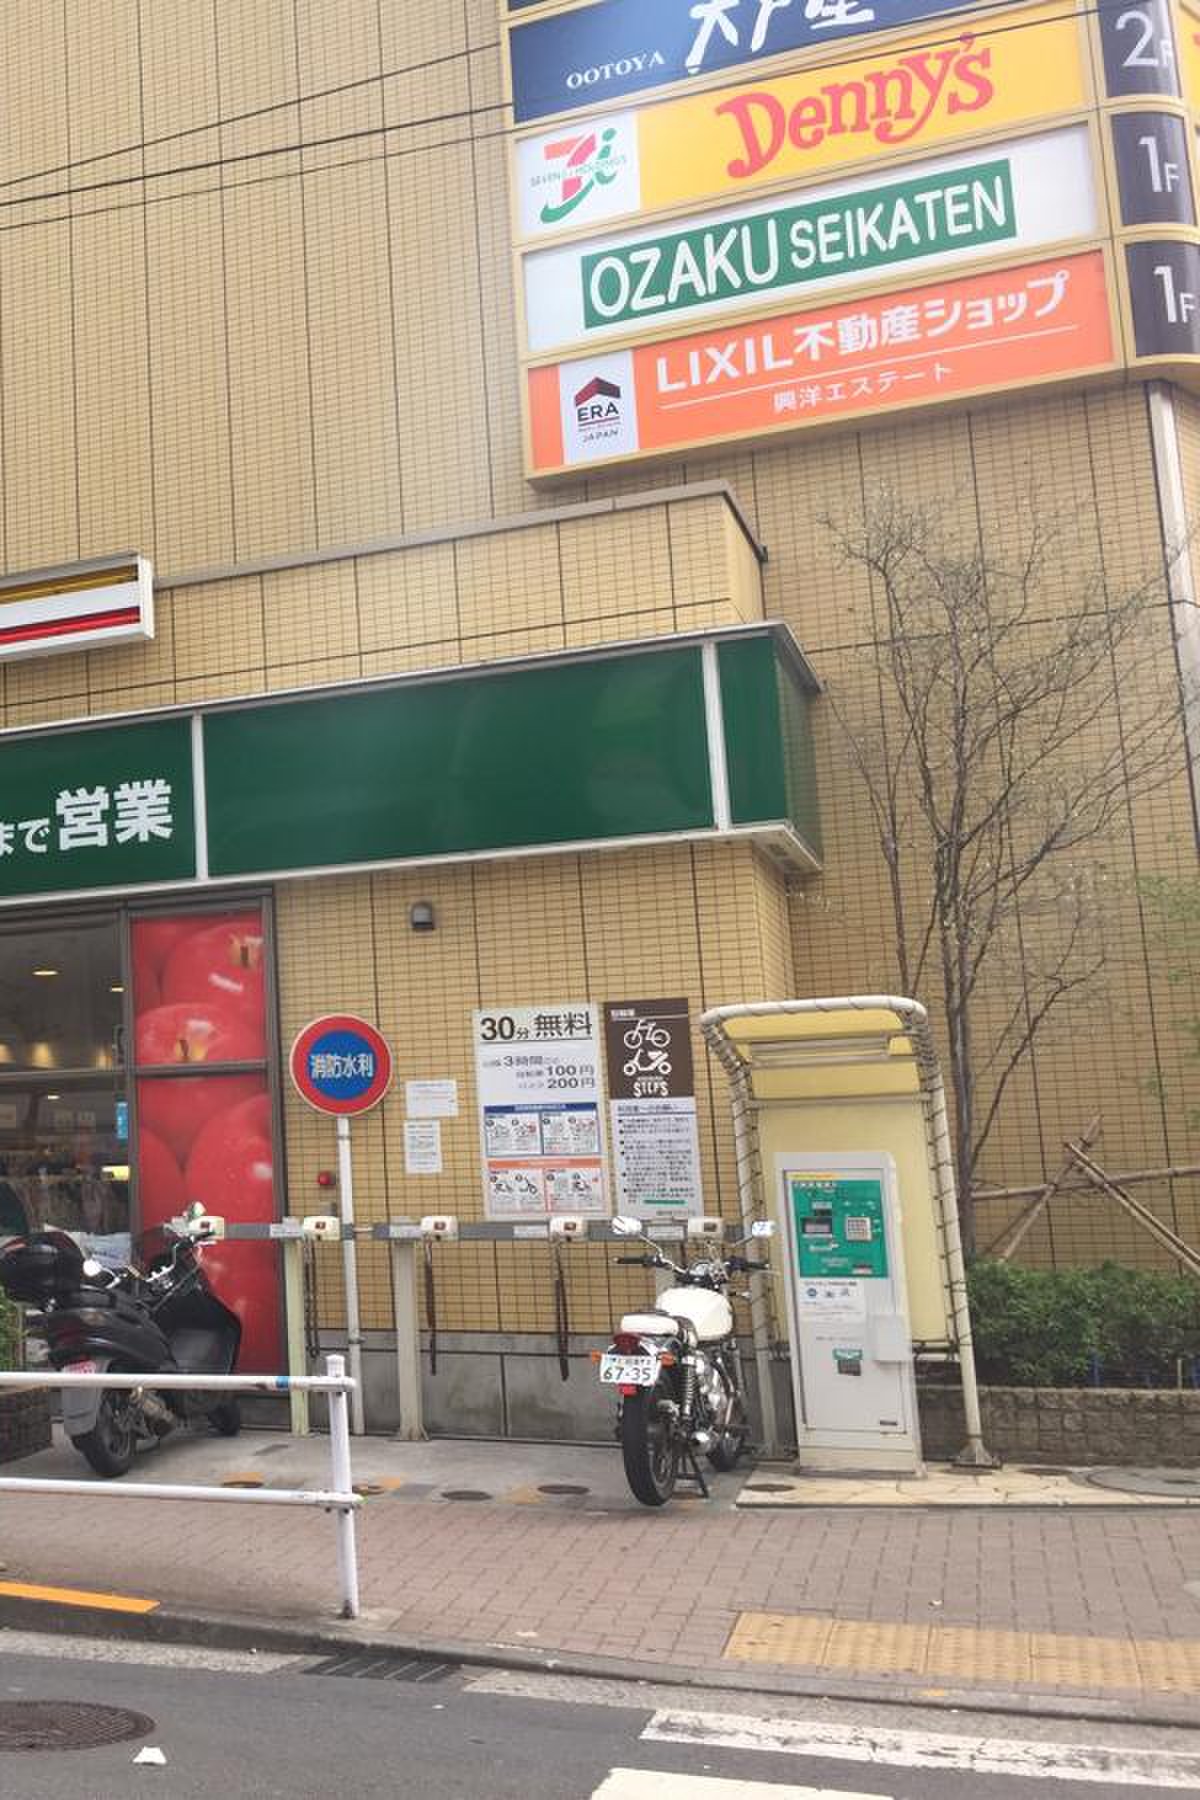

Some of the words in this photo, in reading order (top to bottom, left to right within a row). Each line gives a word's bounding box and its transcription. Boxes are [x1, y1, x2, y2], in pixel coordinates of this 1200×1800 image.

[1114, 10, 1173, 68] 2F
[565, 50, 666, 90] OOTOYA
[715, 32, 995, 178] Denny's
[1138, 136, 1180, 193] 1F
[590, 219, 779, 317] OZAKU
[791, 175, 1008, 269] SEIKATEN
[1153, 265, 1195, 324] 1F
[577, 401, 620, 422] ERA
[582, 428, 619, 443] JAPAN
[480, 1015, 529, 1041] 30分
[533, 1011, 593, 1038] 無料
[309, 1053, 374, 1079] 消防水利
[547, 1064, 595, 1077] 100円
[547, 1076, 596, 1090] 200円
[603, 1366, 652, 1381] 67-35
